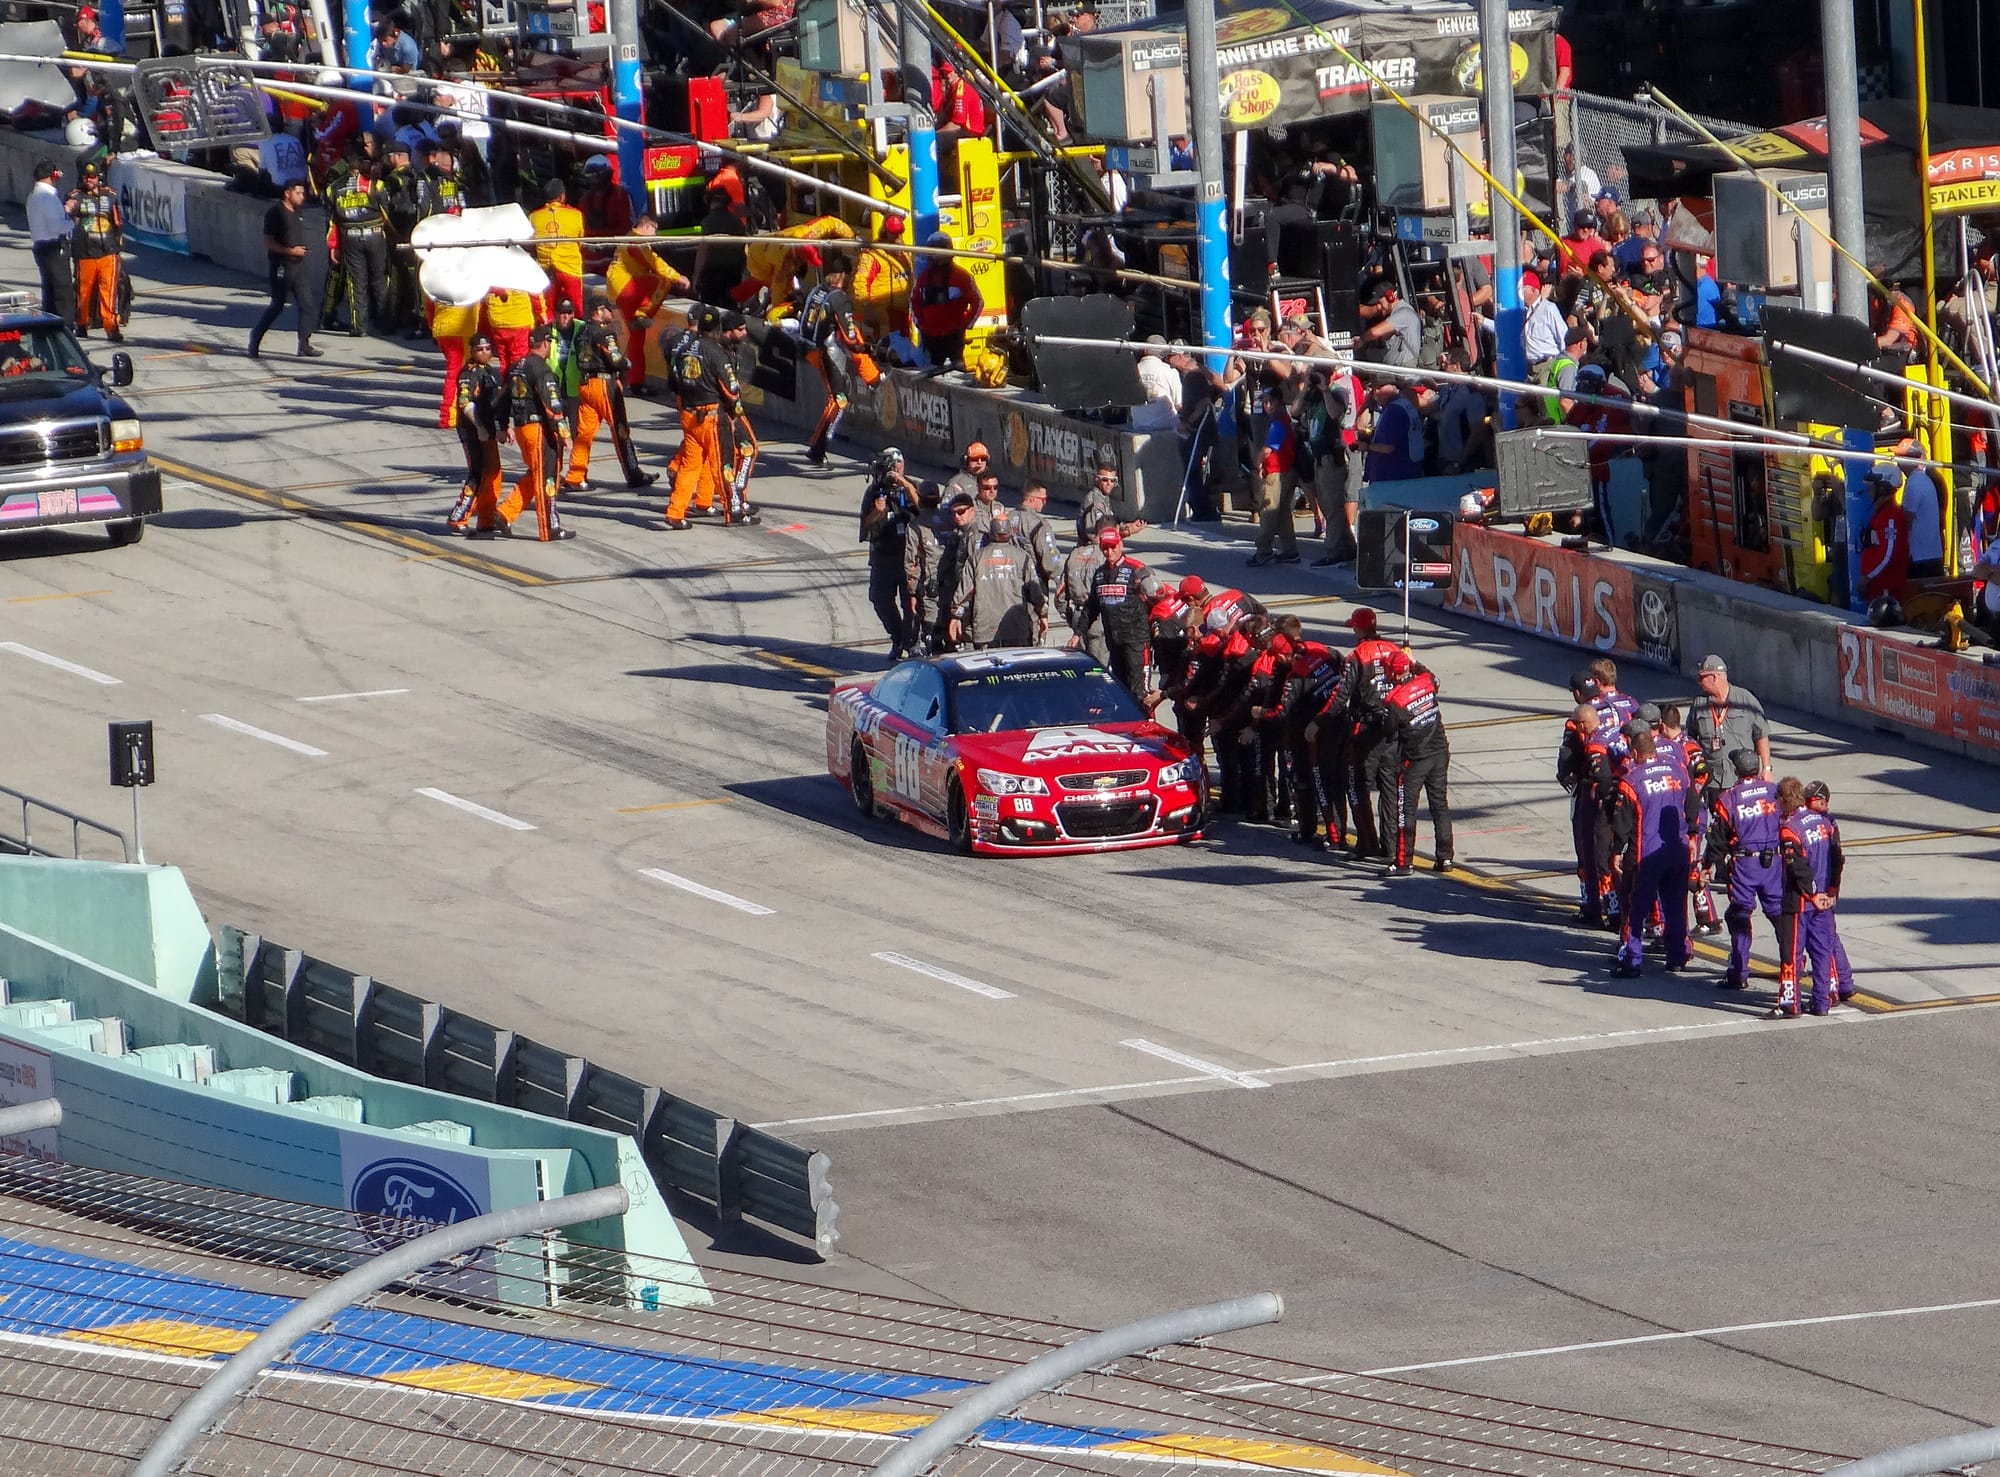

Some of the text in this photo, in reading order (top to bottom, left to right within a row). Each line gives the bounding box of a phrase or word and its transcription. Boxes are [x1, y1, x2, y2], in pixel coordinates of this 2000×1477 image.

[1436, 10, 1533, 35] DENVER RESS
[622, 46, 636, 58] 06
[1216, 27, 1351, 67] RNITURE ROW
[1234, 73, 1263, 90] Bass
[1315, 57, 1418, 89] TRACKER
[1236, 88, 1260, 102] Pro
[1239, 98, 1275, 117] Shops
[971, 187, 995, 203] 22
[1207, 184, 1222, 198] 04
[1930, 184, 1998, 206] STANLEY
[1279, 298, 1307, 318] 78
[900, 386, 951, 426] TRACKER
[1029, 421, 1081, 463] TRACKER
[1411, 519, 1433, 529] Ford
[1454, 547, 1618, 650] ARRIS
[1642, 641, 1672, 663] TOYOTA
[1003, 671, 1061, 681] MONSTER
[1841, 631, 1876, 707] 21
[1021, 744, 1148, 763] AXALTA
[894, 732, 921, 801] 88
[1643, 775, 1682, 795] FedEx
[1013, 797, 1034, 812] 88
[1064, 791, 1132, 802] CHEVROLET
[1736, 800, 1777, 821] FedEx
[1779, 963, 1795, 1004] FedEx
